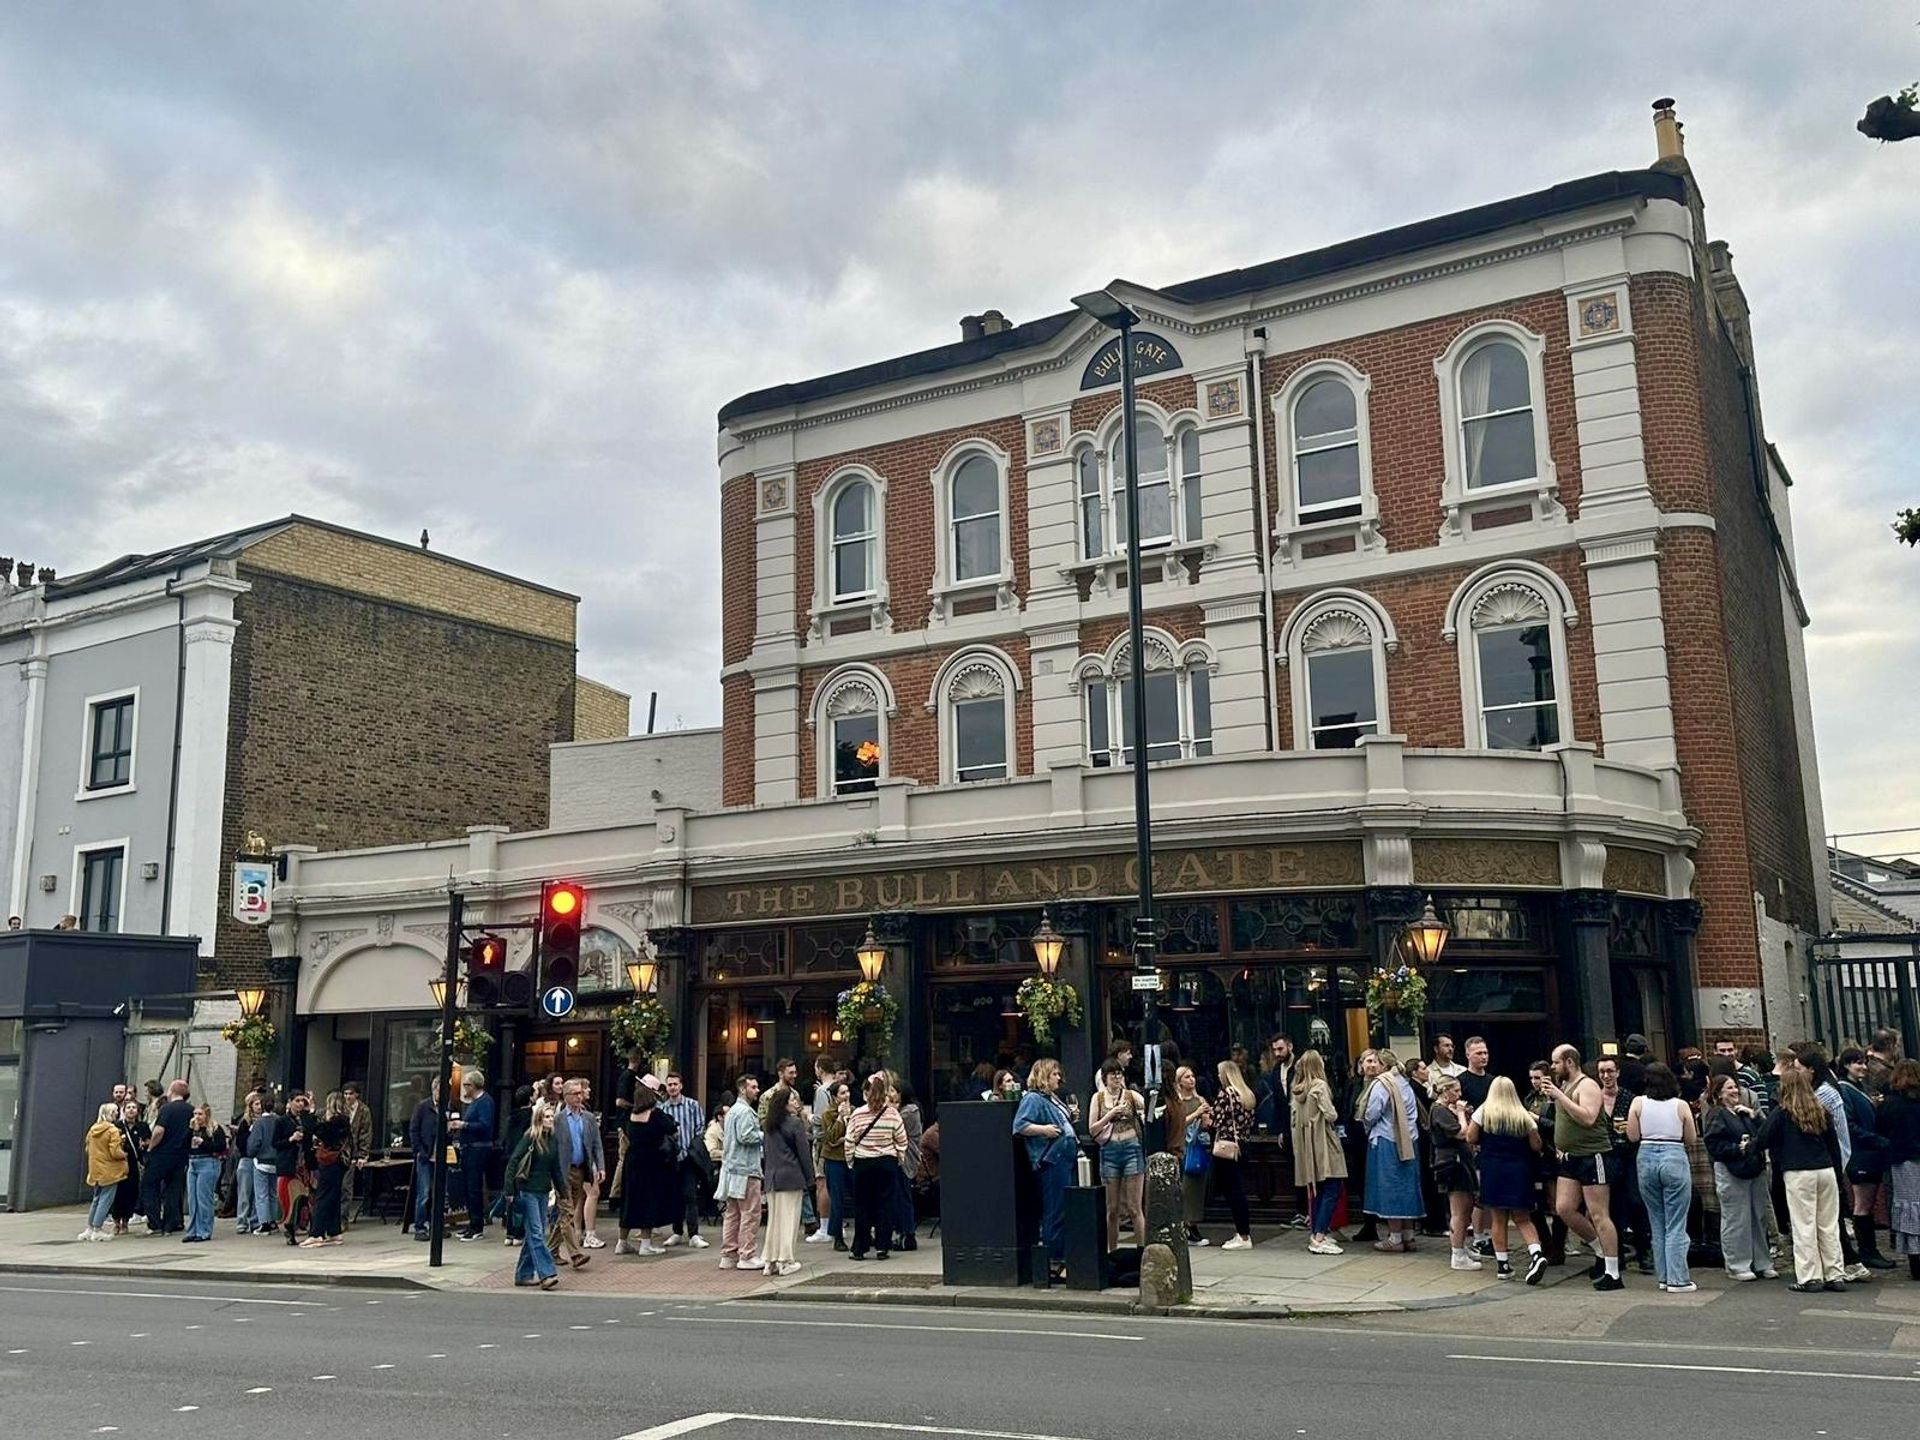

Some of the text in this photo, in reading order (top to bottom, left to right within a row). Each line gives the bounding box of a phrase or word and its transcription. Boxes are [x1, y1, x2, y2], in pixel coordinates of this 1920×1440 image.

[1136, 341, 1167, 364] GATE
[727, 846, 1307, 915] THE BULL AND GATE
